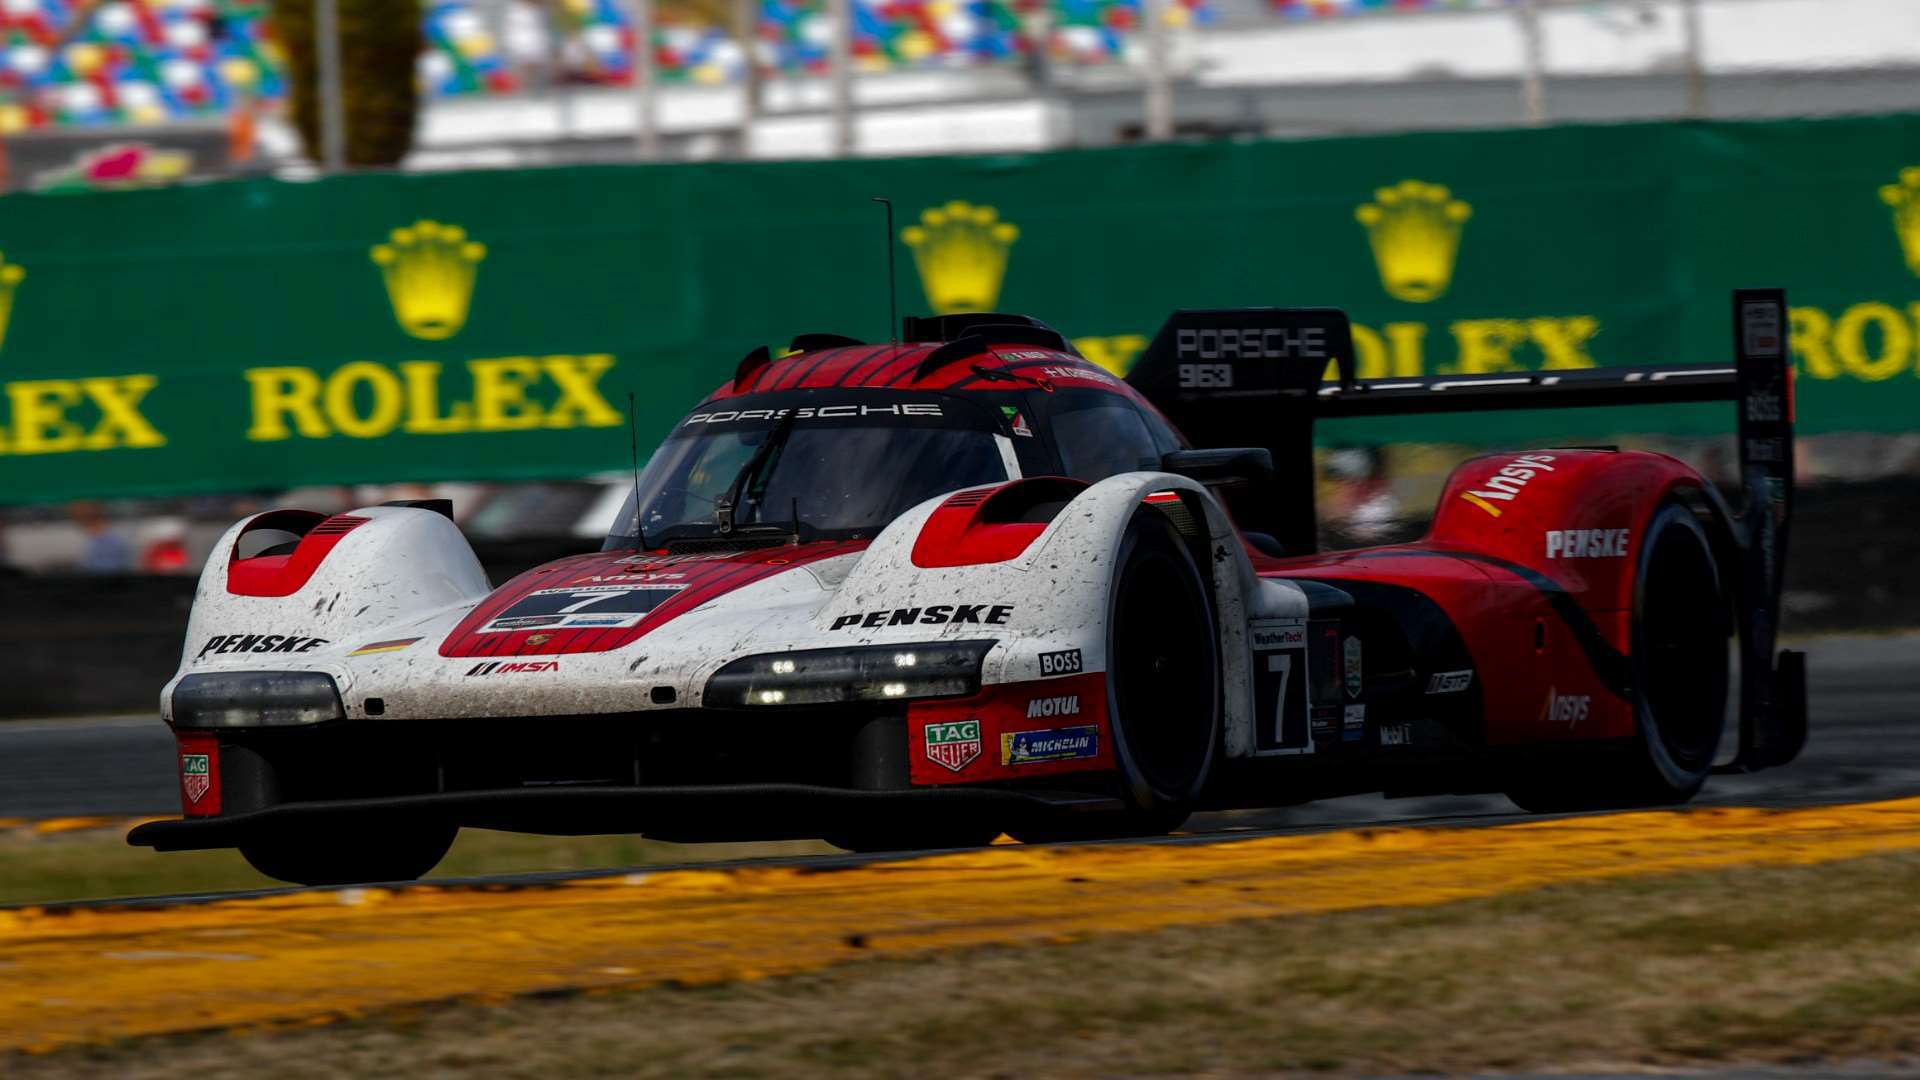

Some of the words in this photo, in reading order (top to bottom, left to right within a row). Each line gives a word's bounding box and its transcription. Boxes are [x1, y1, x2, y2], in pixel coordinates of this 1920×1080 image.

[1176, 327, 1328, 359] PORSCHE
[1177, 362, 1234, 389] 963
[244, 353, 625, 441] ROLEX
[0, 374, 168, 456] EX
[683, 402, 944, 427] PORSCHE
[1458, 453, 1558, 518] Ansys
[1545, 527, 1631, 560] PENSKE
[556, 589, 632, 614] 7
[830, 604, 1015, 631] PENSKE
[197, 633, 330, 659] PENSKE
[1253, 631, 1304, 645] WeatherTech
[494, 660, 560, 674] IMSA
[1042, 651, 1081, 674] BOSS
[1026, 695, 1081, 719] MOTUL
[1266, 653, 1293, 745] 7
[929, 723, 977, 742] TAG
[1030, 736, 1090, 754] MICHELIN
[184, 757, 207, 773] TAG
[929, 744, 979, 769] HEUER
